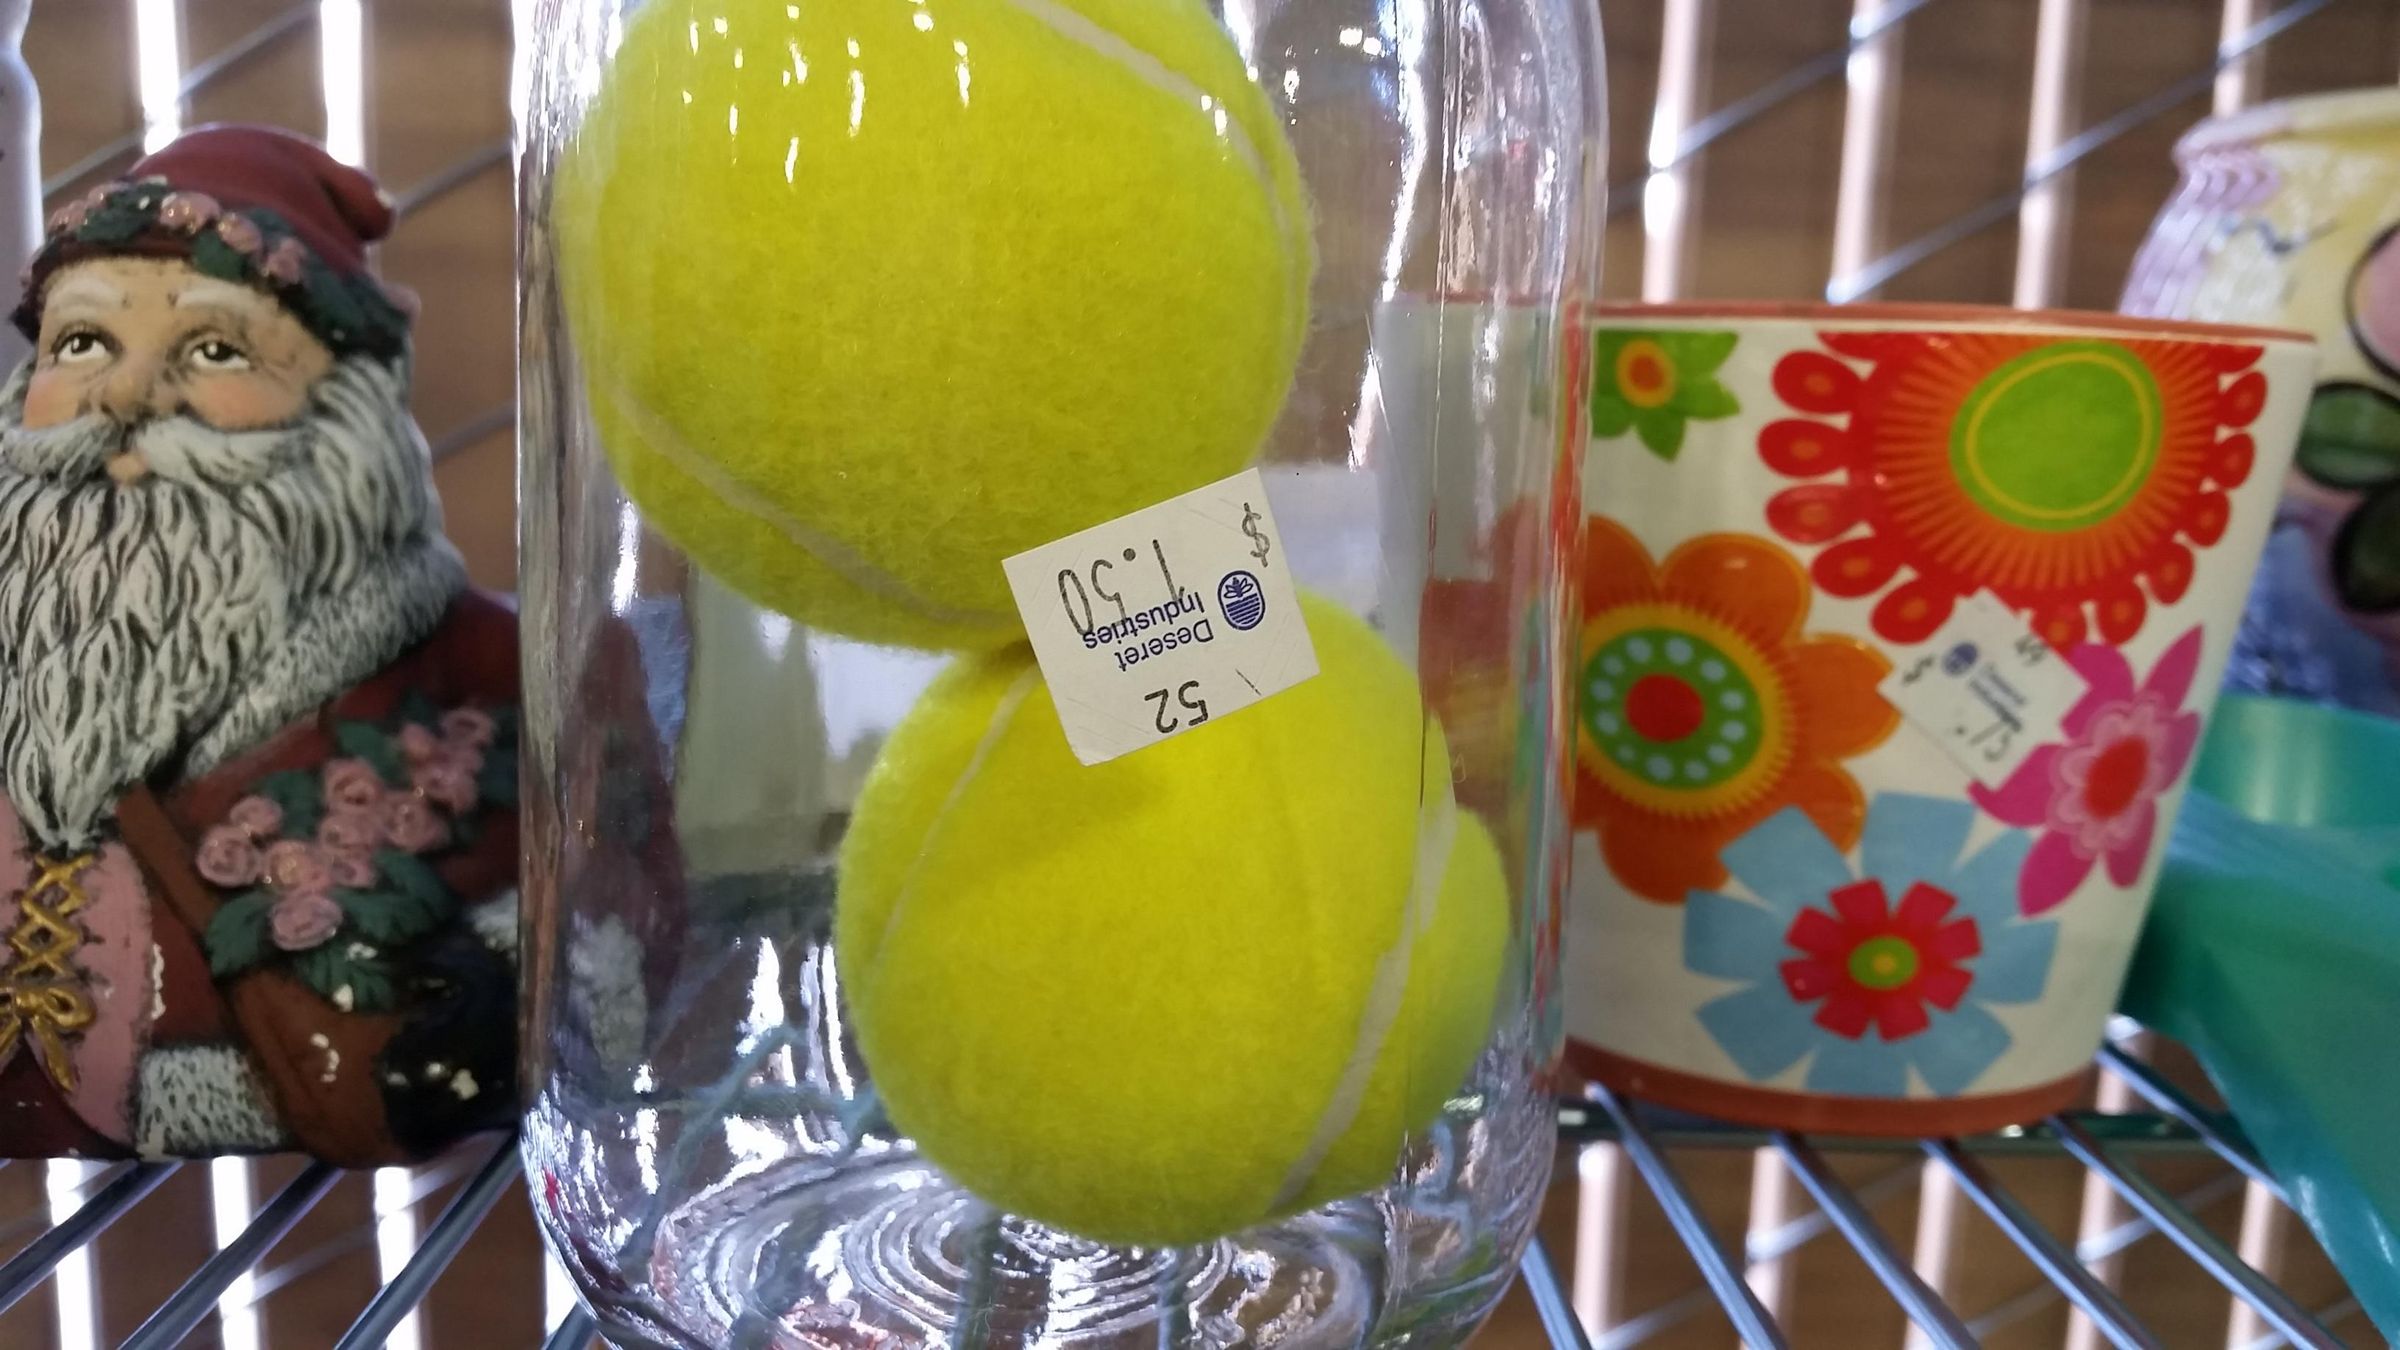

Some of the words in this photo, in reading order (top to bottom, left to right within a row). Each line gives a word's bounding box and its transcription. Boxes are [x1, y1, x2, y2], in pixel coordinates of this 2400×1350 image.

[1242, 502, 1270, 568] $
[1058, 539, 1186, 635] 1.50
[1083, 592, 1205, 649] Industries
[1115, 619, 1214, 672] Deseret
[1145, 681, 1208, 734] 52
